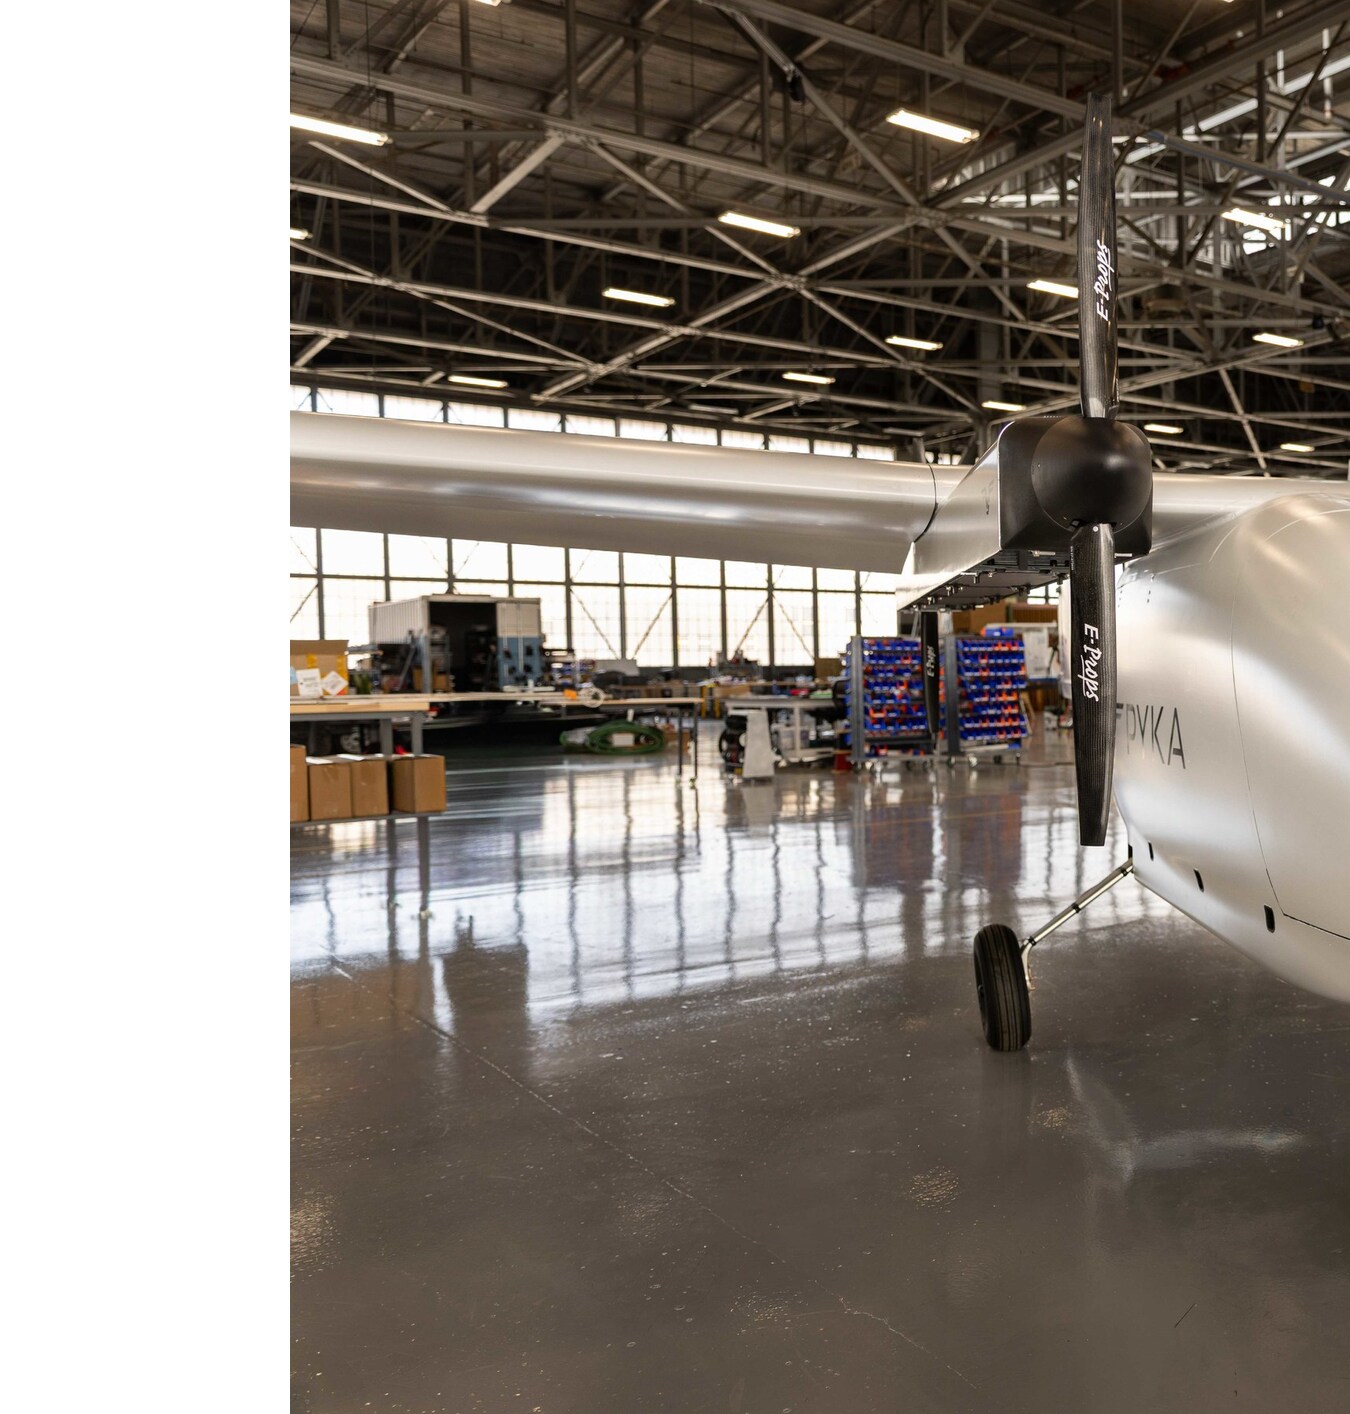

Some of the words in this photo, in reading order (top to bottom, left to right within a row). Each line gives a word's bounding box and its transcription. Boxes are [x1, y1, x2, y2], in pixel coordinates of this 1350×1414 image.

[1093, 239, 1115, 322] E-Props
[1077, 622, 1103, 702] E-Props
[1125, 703, 1186, 769] PYKA
